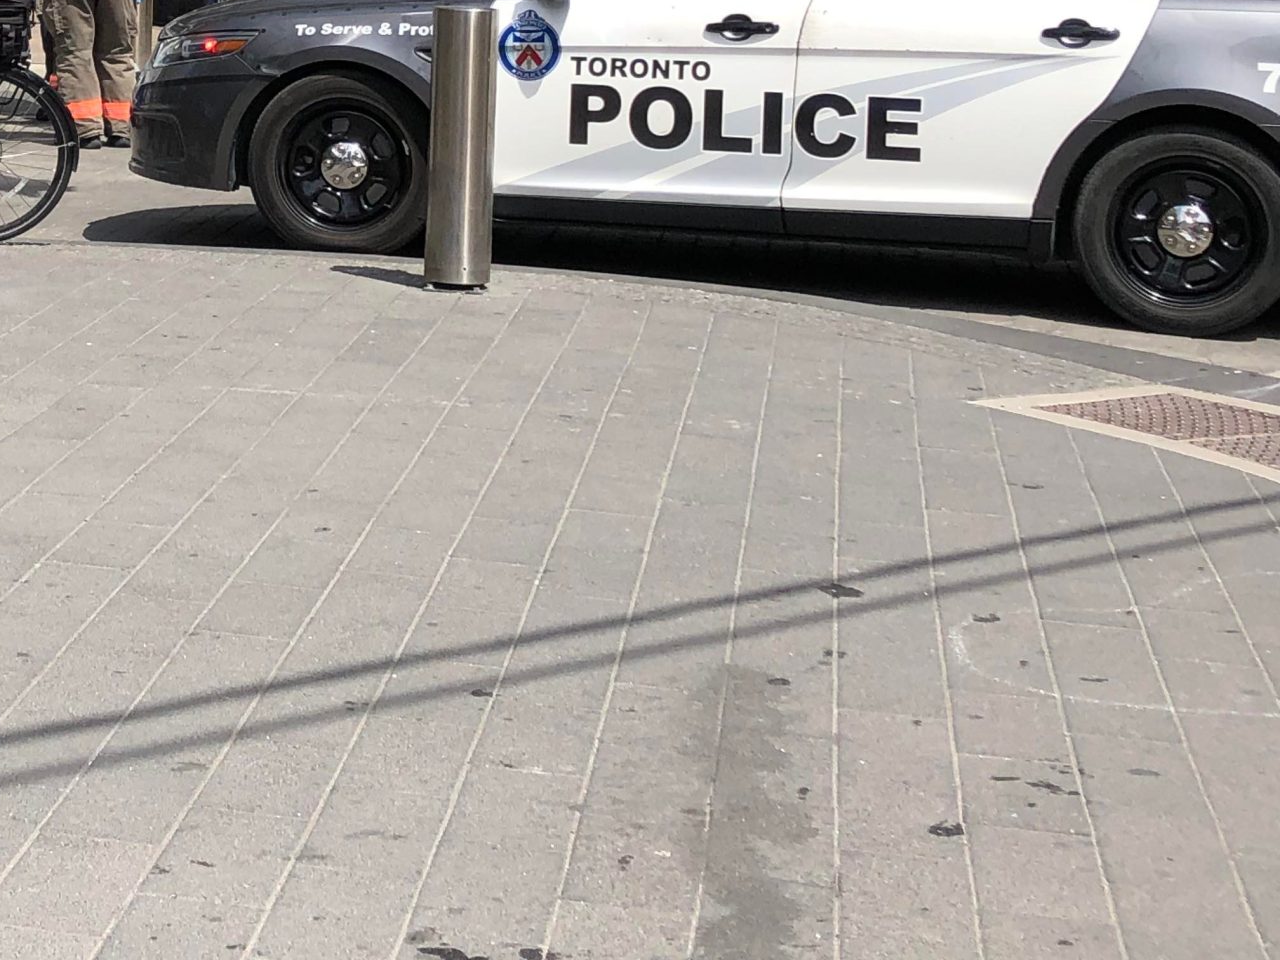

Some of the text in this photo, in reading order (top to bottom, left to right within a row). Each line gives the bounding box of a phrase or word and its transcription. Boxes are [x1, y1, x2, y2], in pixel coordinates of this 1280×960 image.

[295, 23, 317, 37] To
[320, 23, 373, 36] Serve
[377, 23, 393, 36] &
[570, 56, 712, 81] TORONTO
[569, 83, 923, 162] POLICE
